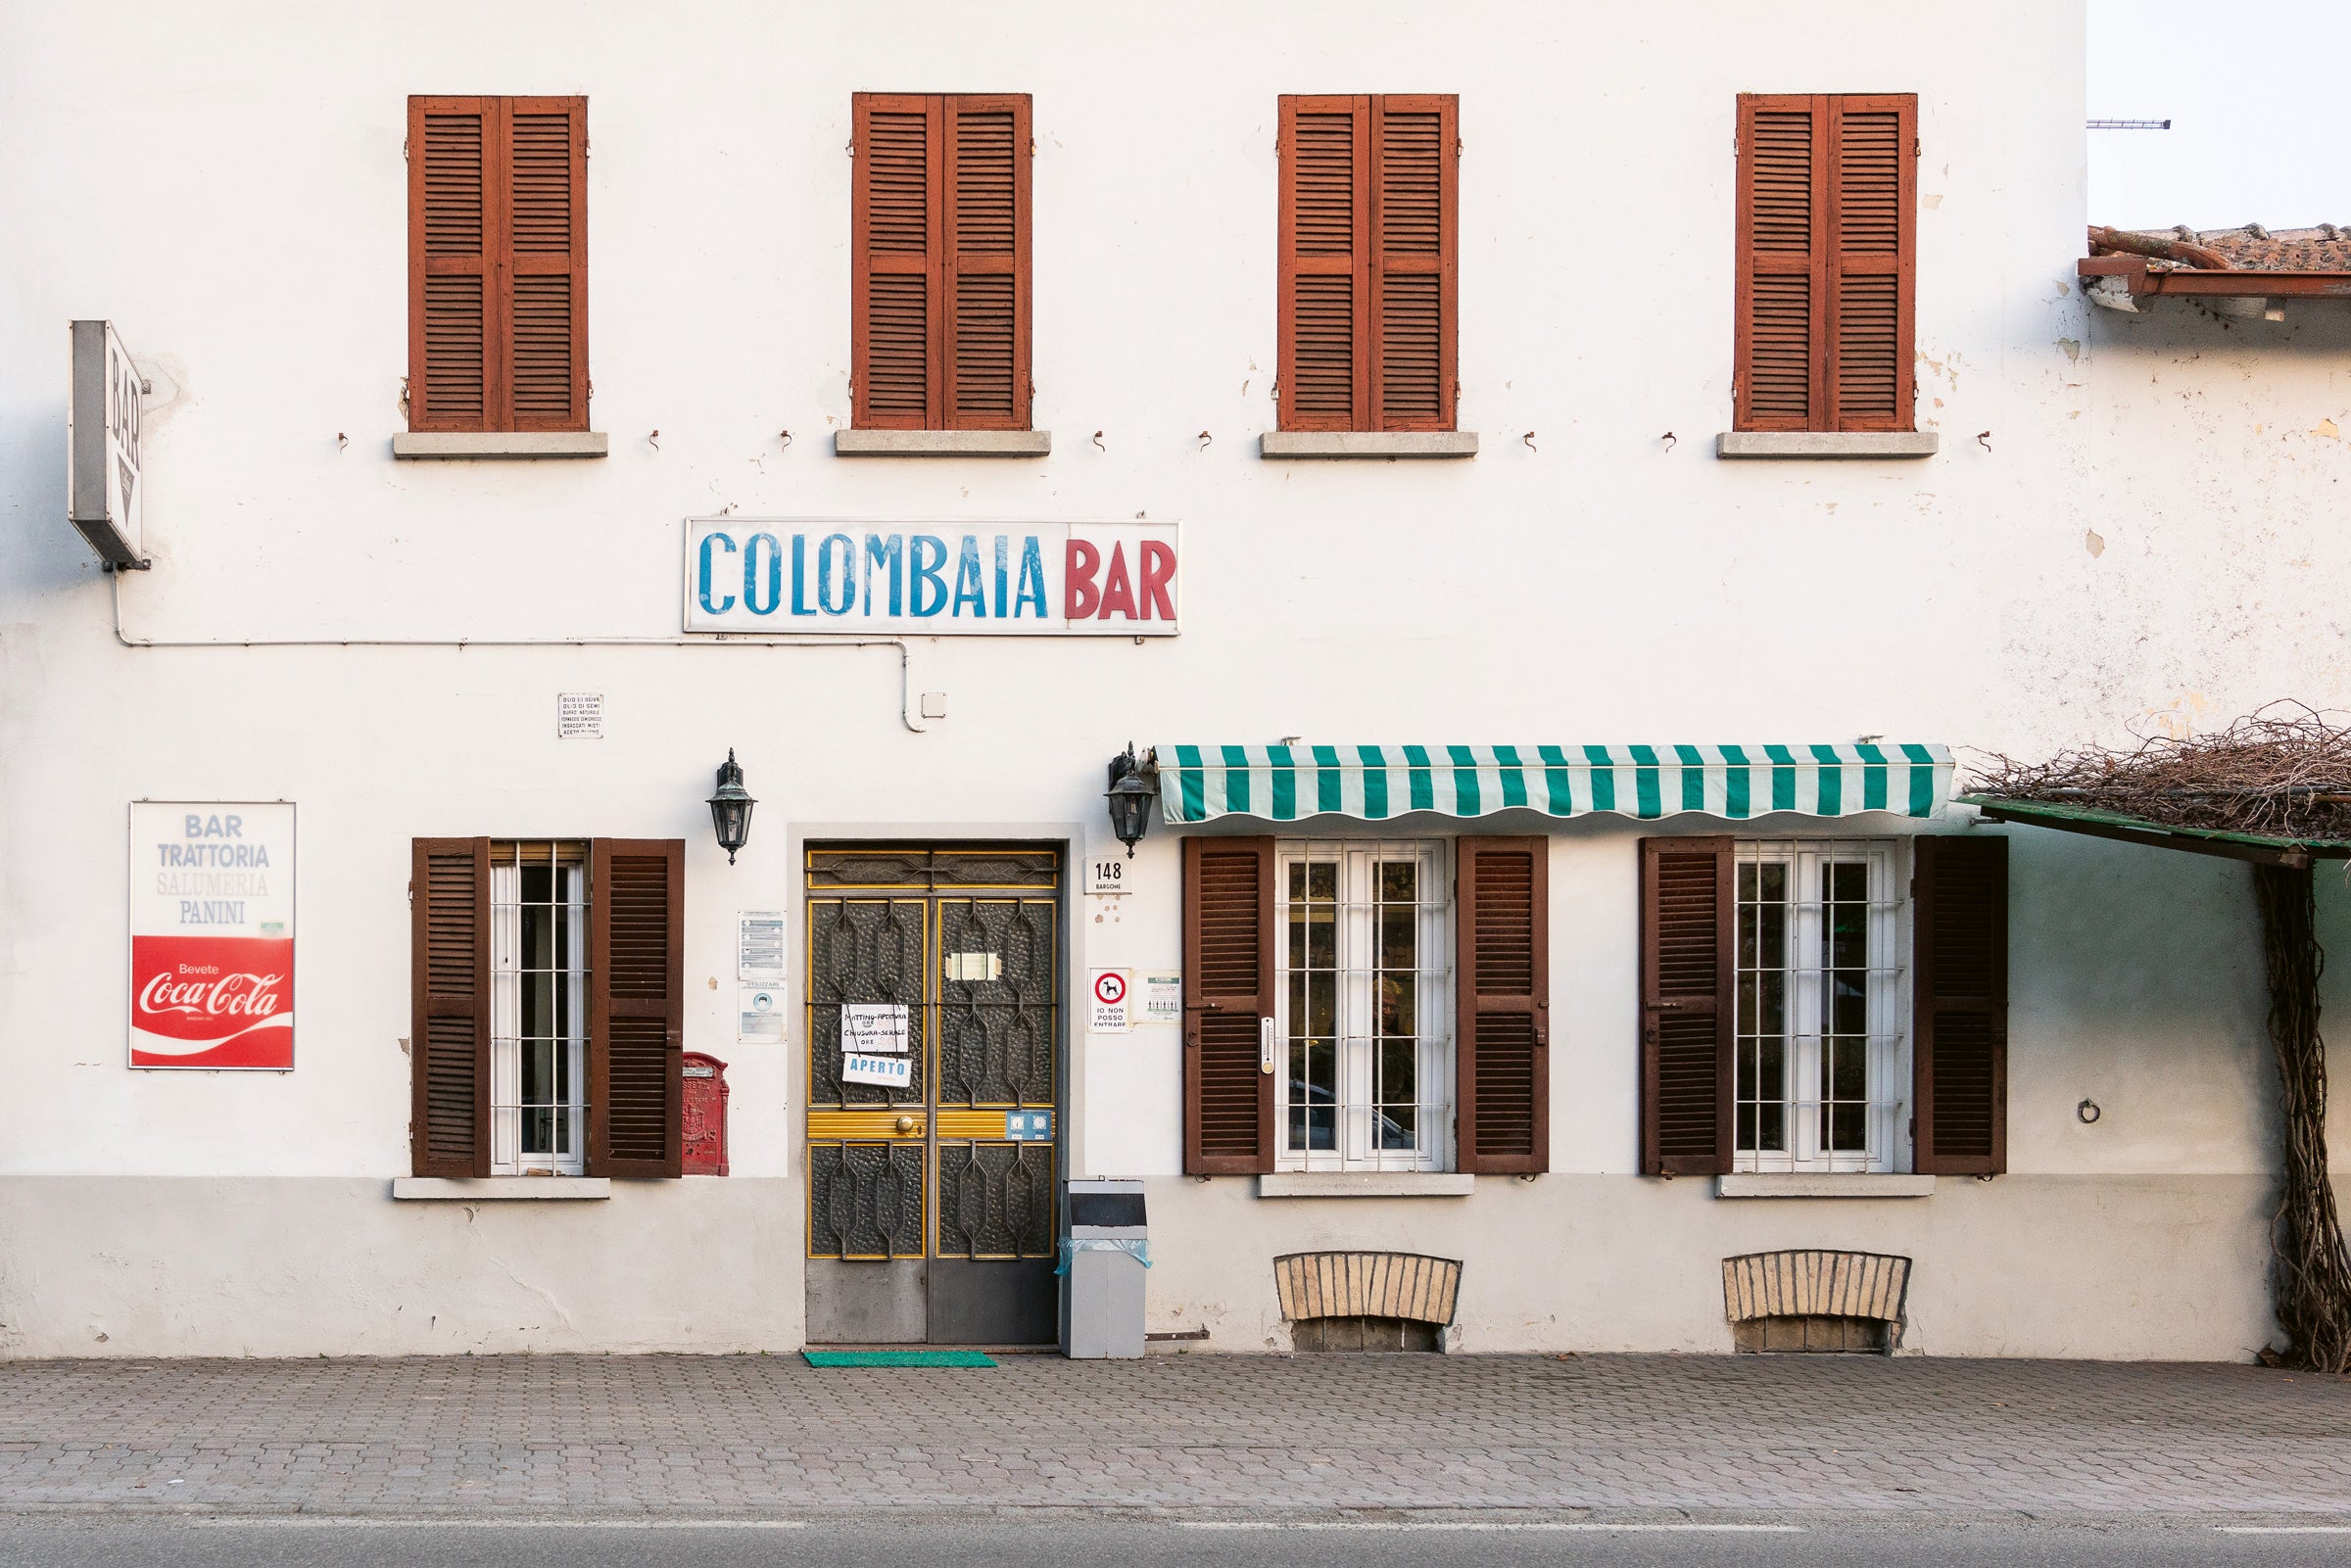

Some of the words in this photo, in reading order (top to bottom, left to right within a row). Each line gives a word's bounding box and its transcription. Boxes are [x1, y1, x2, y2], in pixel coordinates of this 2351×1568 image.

[113, 348, 140, 473] BAR
[698, 532, 1049, 619] COLOMBAIA
[1065, 539, 1176, 620] BAR
[185, 815, 243, 838] BAR
[158, 844, 269, 868] TRATTORIA
[1095, 863, 1122, 880] 148
[157, 872, 269, 897] SALUMERIA
[180, 900, 245, 924] PANINI
[179, 963, 219, 974] Bevete
[139, 972, 286, 1016] Coca-Cola
[850, 1058, 905, 1075] APERTO
